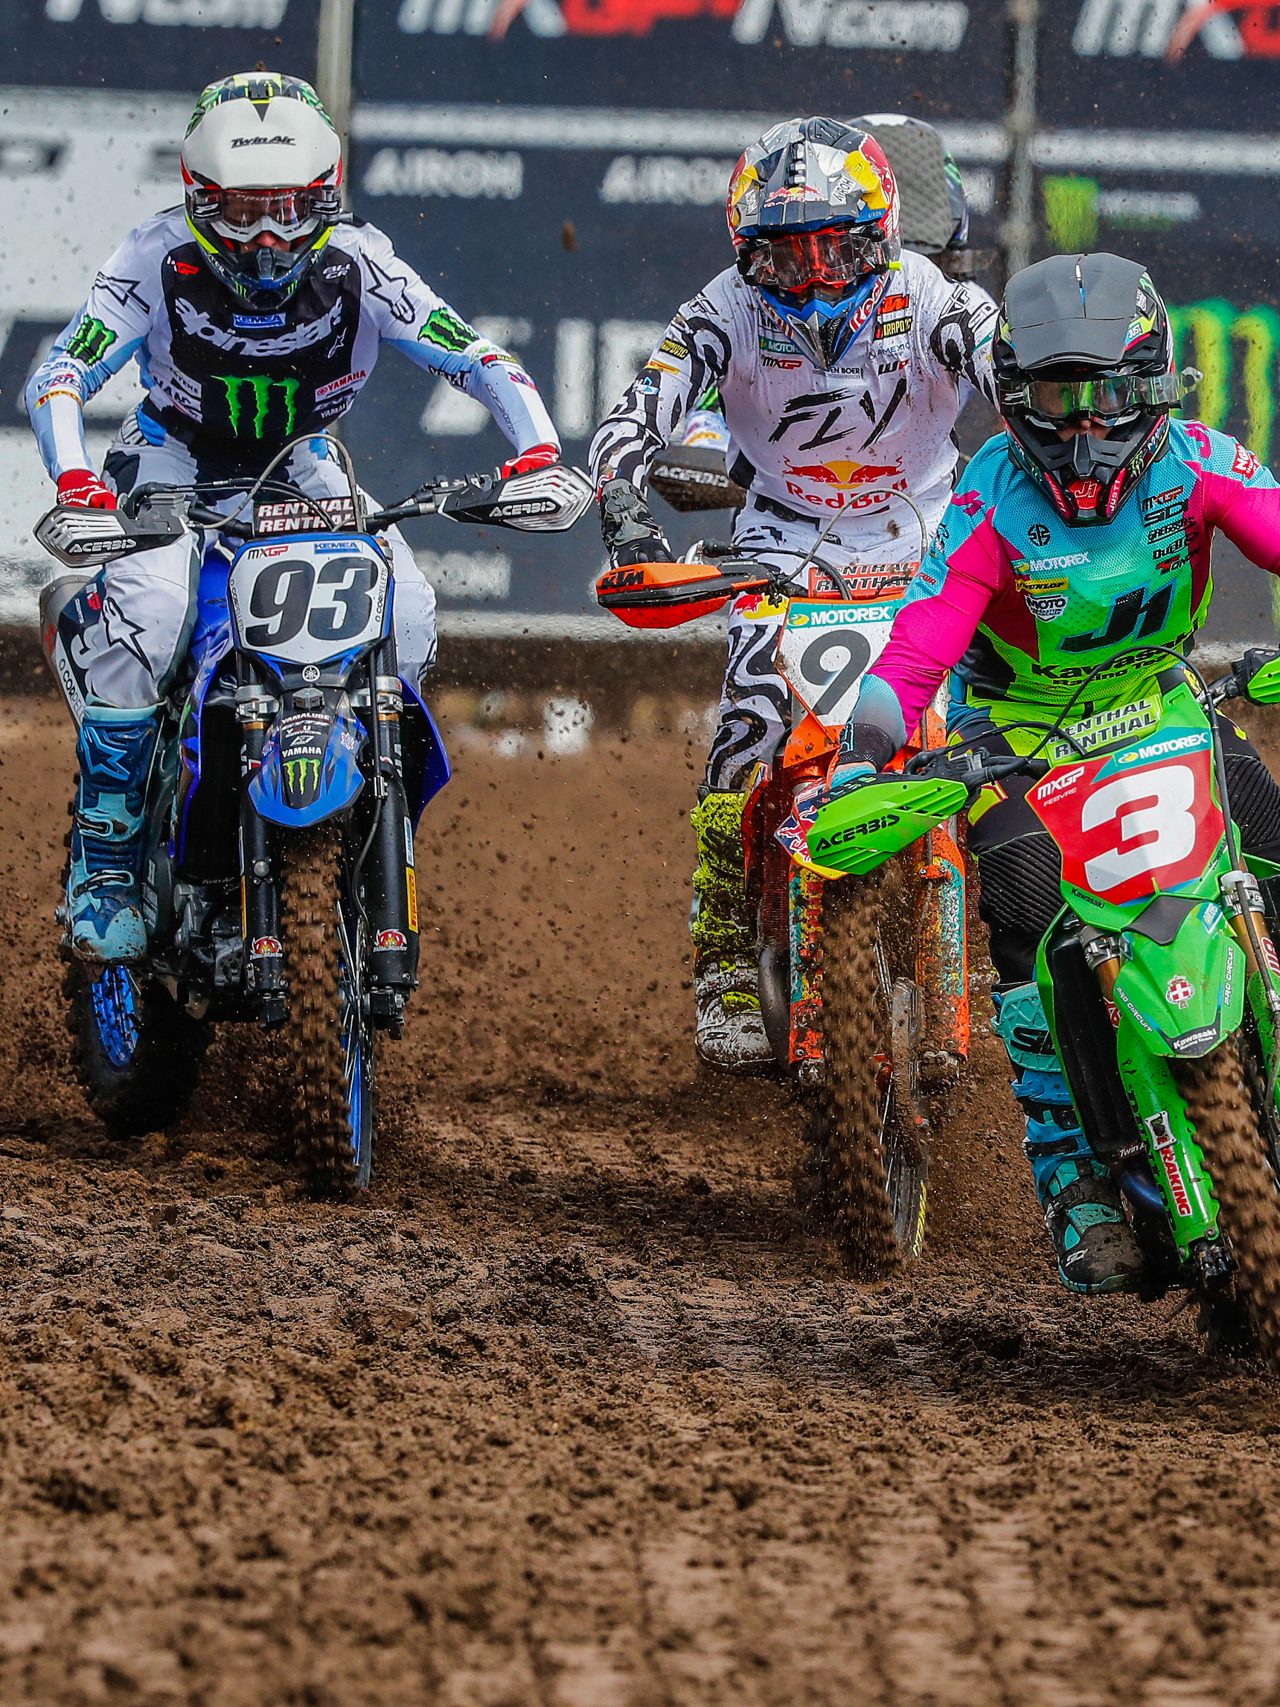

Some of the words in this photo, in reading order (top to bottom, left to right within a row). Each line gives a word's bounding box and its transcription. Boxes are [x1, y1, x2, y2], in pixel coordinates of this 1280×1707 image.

[327, 370, 366, 391] YAMAHA
[785, 481, 847, 510] Red
[851, 478, 909, 510] Bull
[247, 545, 289, 561] MXGP
[602, 570, 645, 589] KTM
[245, 556, 379, 648] 93
[811, 606, 893, 626] MOTOREX
[282, 746, 322, 758] YAMAHA
[1138, 731, 1209, 759] MOTOREX
[1037, 766, 1085, 801] MXGP
[1043, 787, 1078, 808] FEBVRE
[1081, 764, 1196, 892] 3
[1071, 888, 1105, 909] Kawasaki
[1172, 1028, 1218, 1050] Kawasaki
